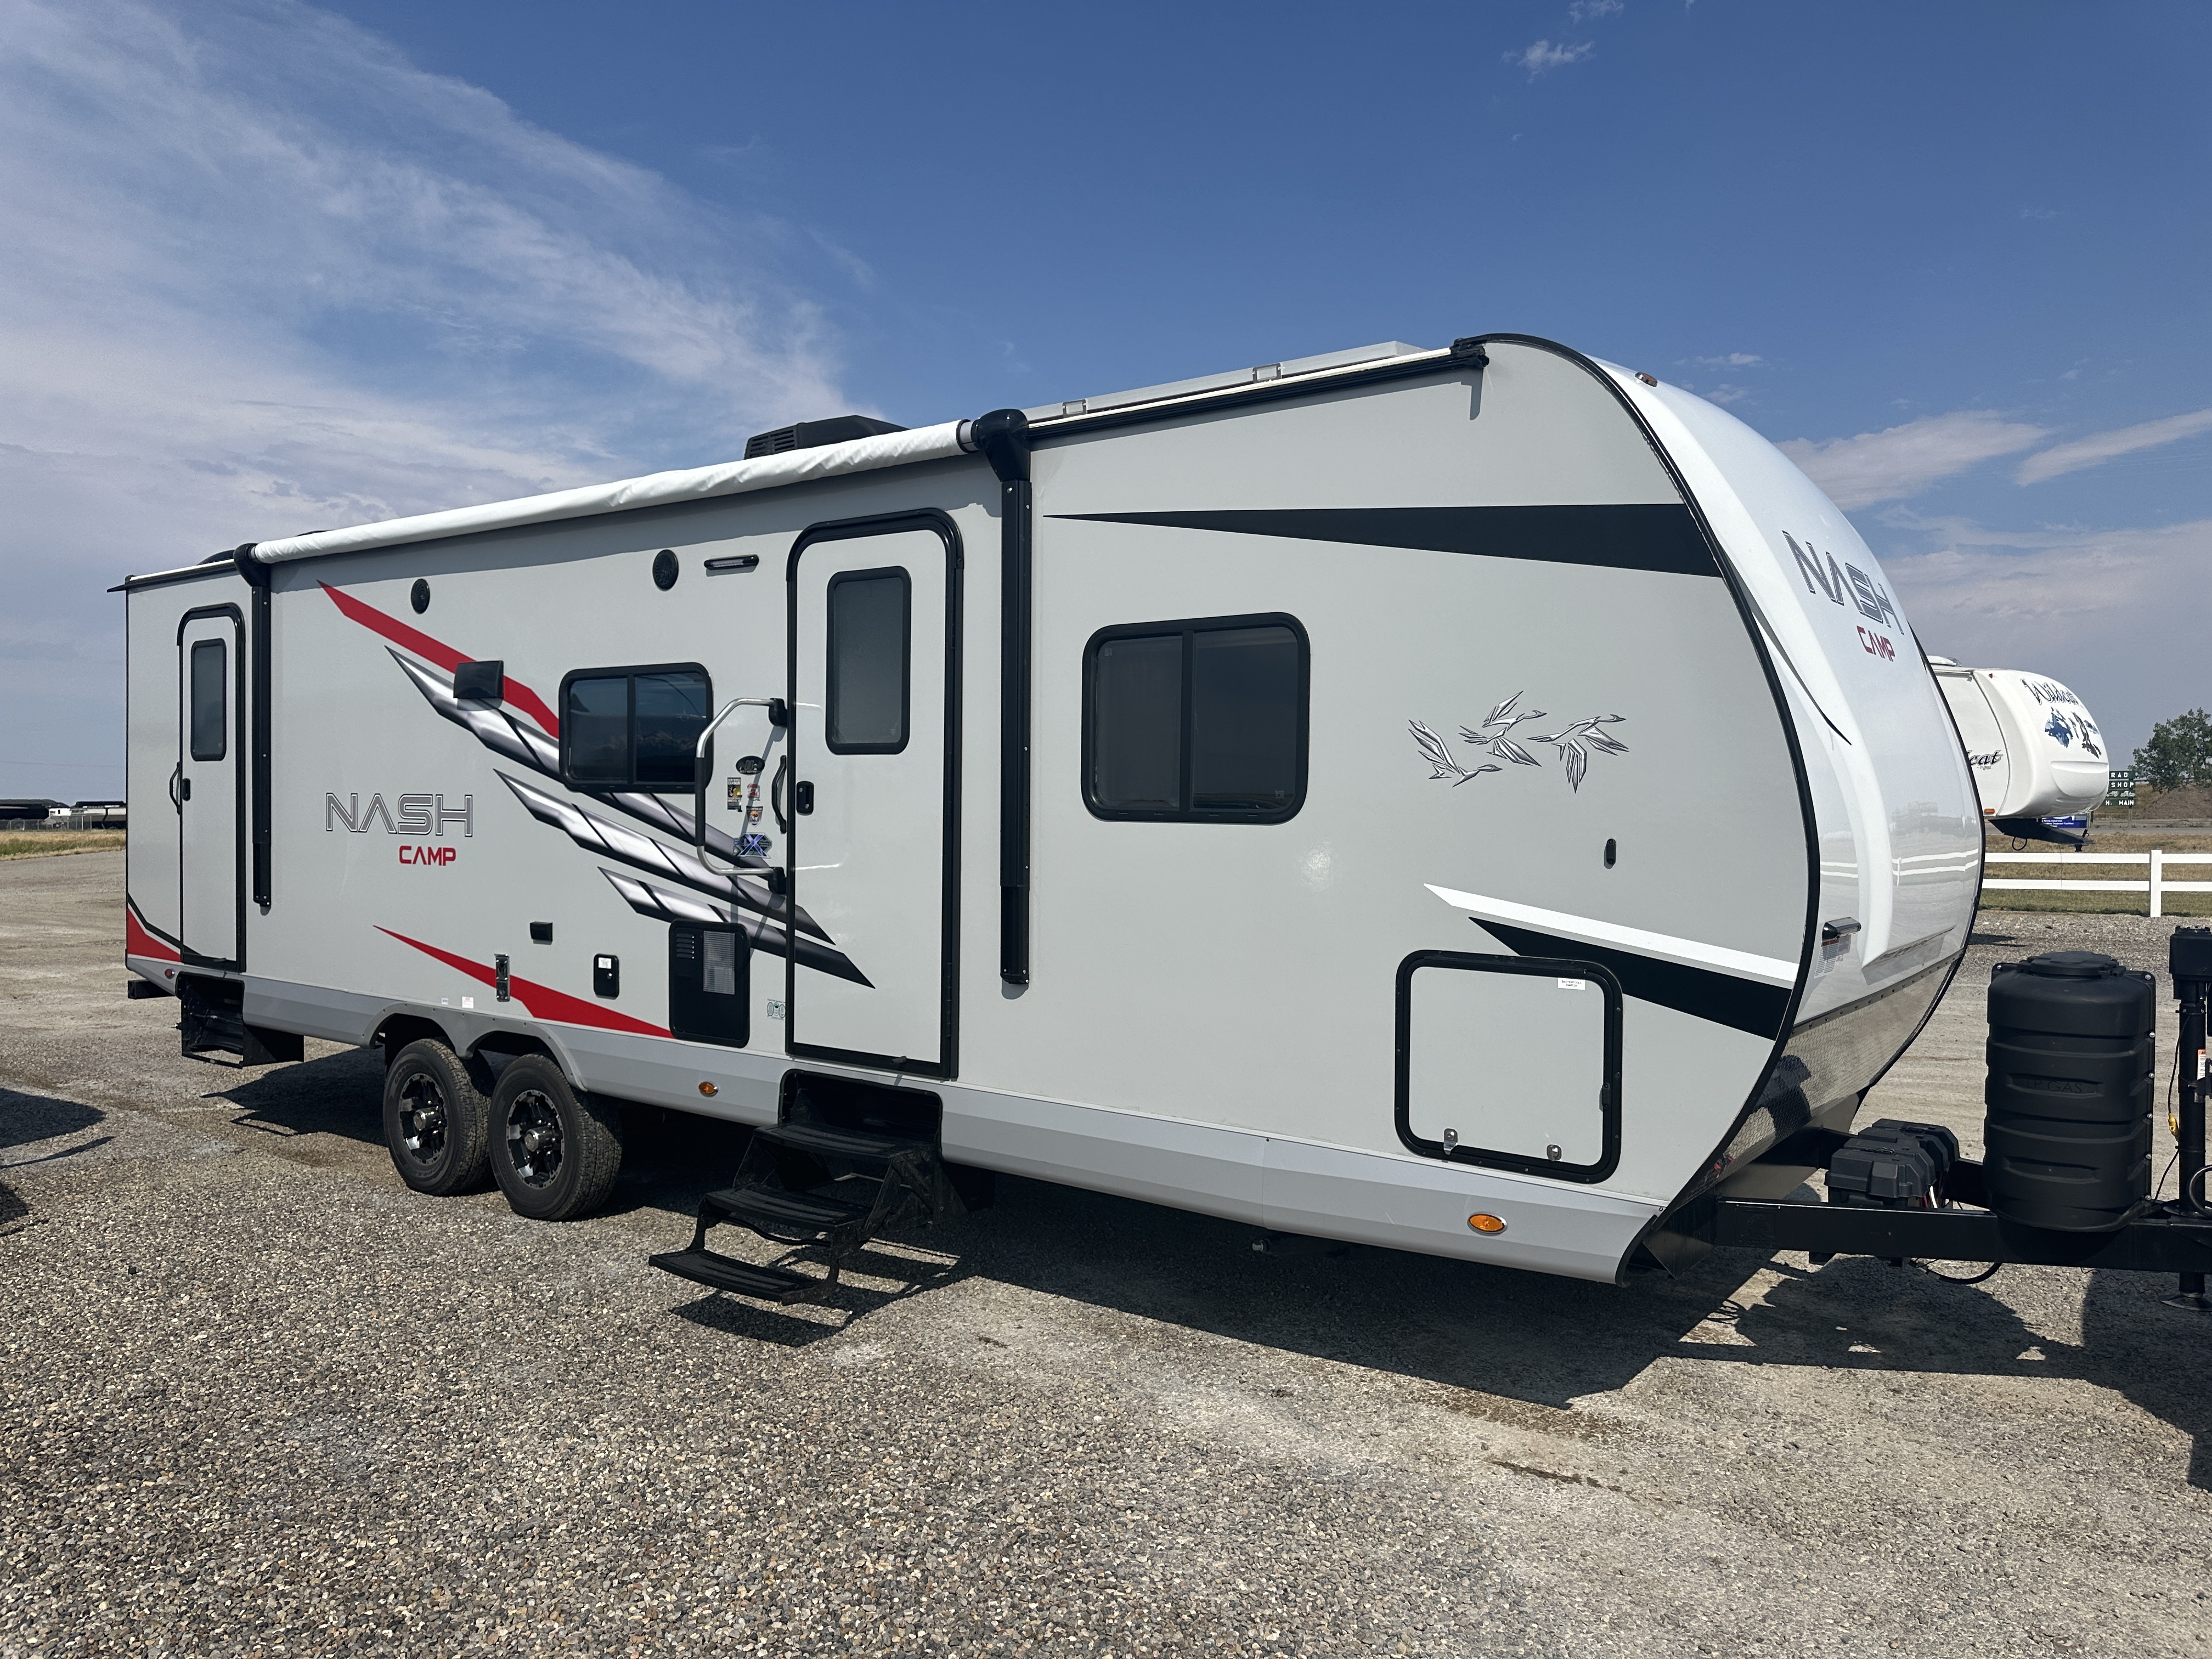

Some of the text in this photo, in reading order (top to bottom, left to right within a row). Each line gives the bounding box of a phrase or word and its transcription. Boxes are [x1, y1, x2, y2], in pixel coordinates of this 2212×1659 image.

[1781, 530, 1904, 635] NASH
[1857, 625, 1895, 662] CAMP
[326, 793, 473, 837] NASH
[399, 845, 456, 866] CAMP
[2027, 1079, 2082, 1094] LP GAS
